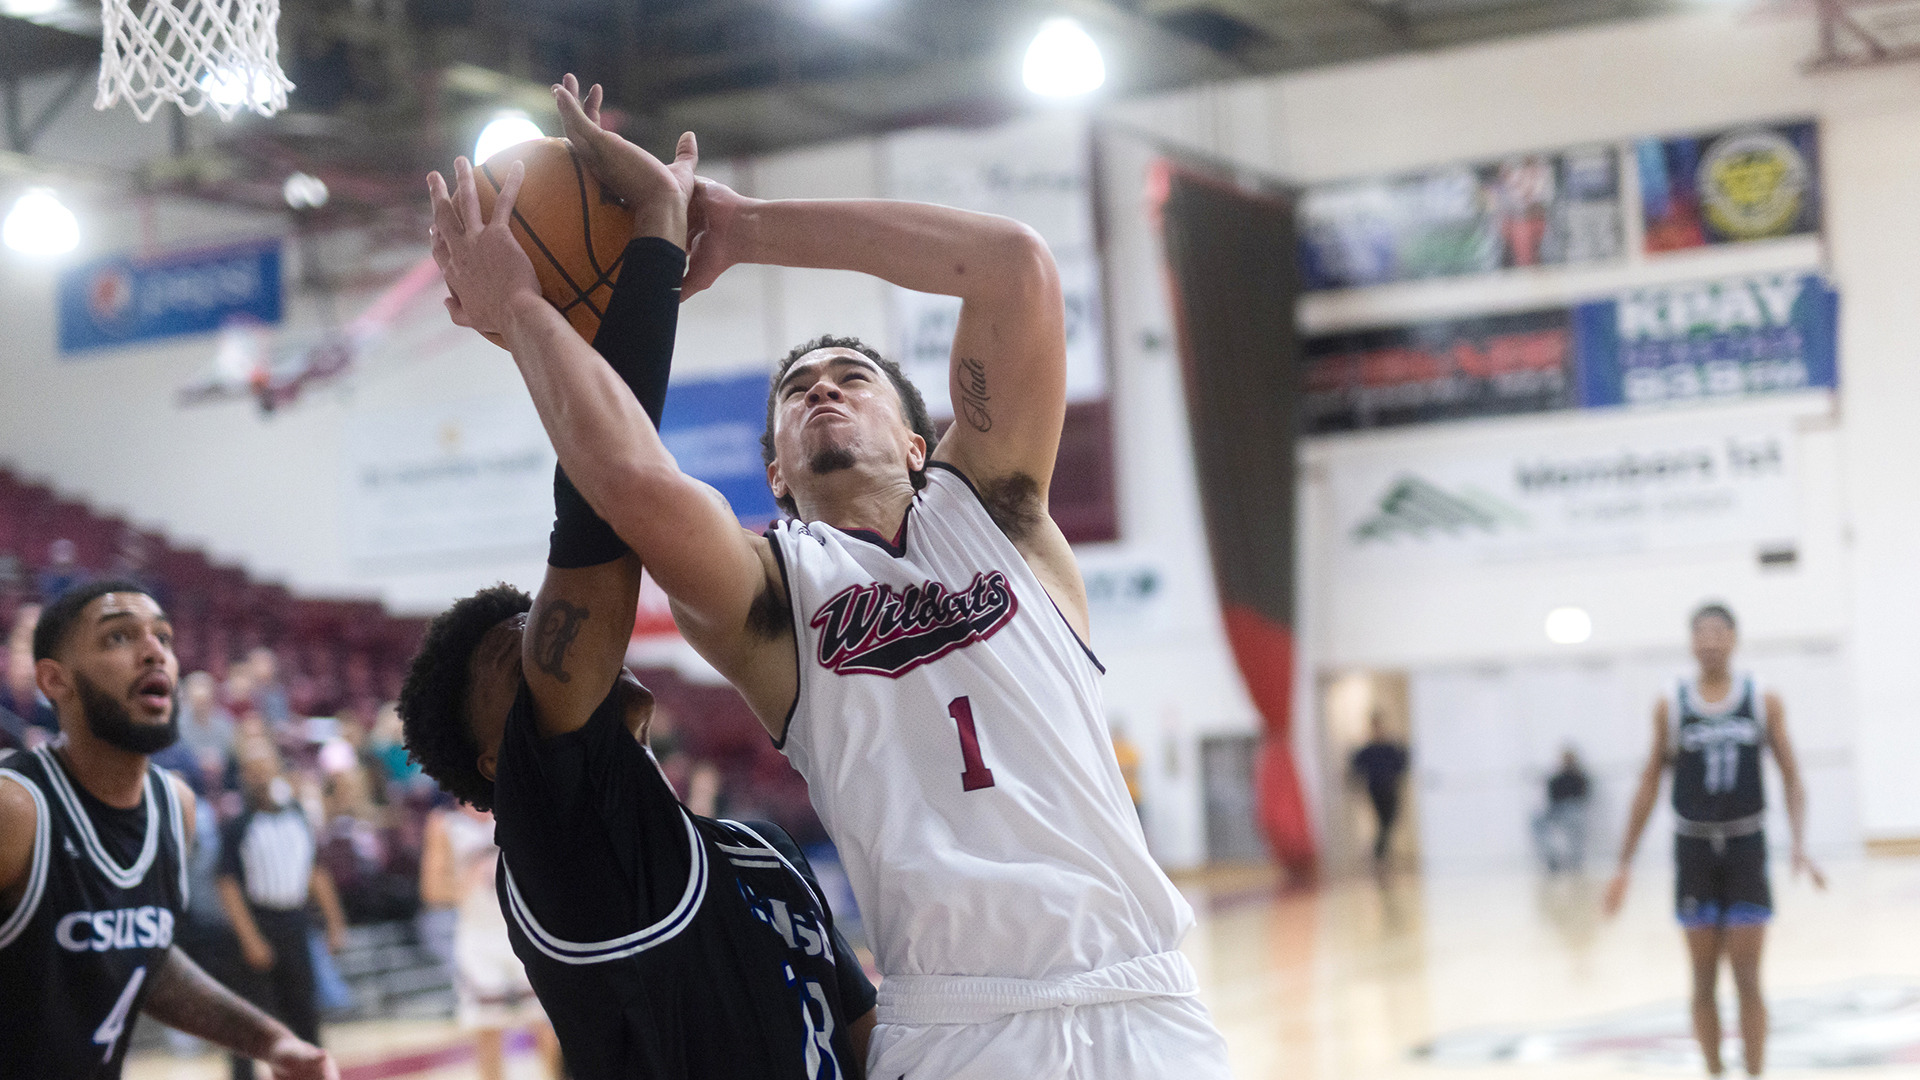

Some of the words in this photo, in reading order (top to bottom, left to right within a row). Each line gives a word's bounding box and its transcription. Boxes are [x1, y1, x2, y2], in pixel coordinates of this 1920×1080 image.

[810, 570, 1018, 670] Wildcats
[947, 696, 996, 792] 1
[55, 904, 175, 952] CSUSB
[92, 965, 147, 1065] 4
